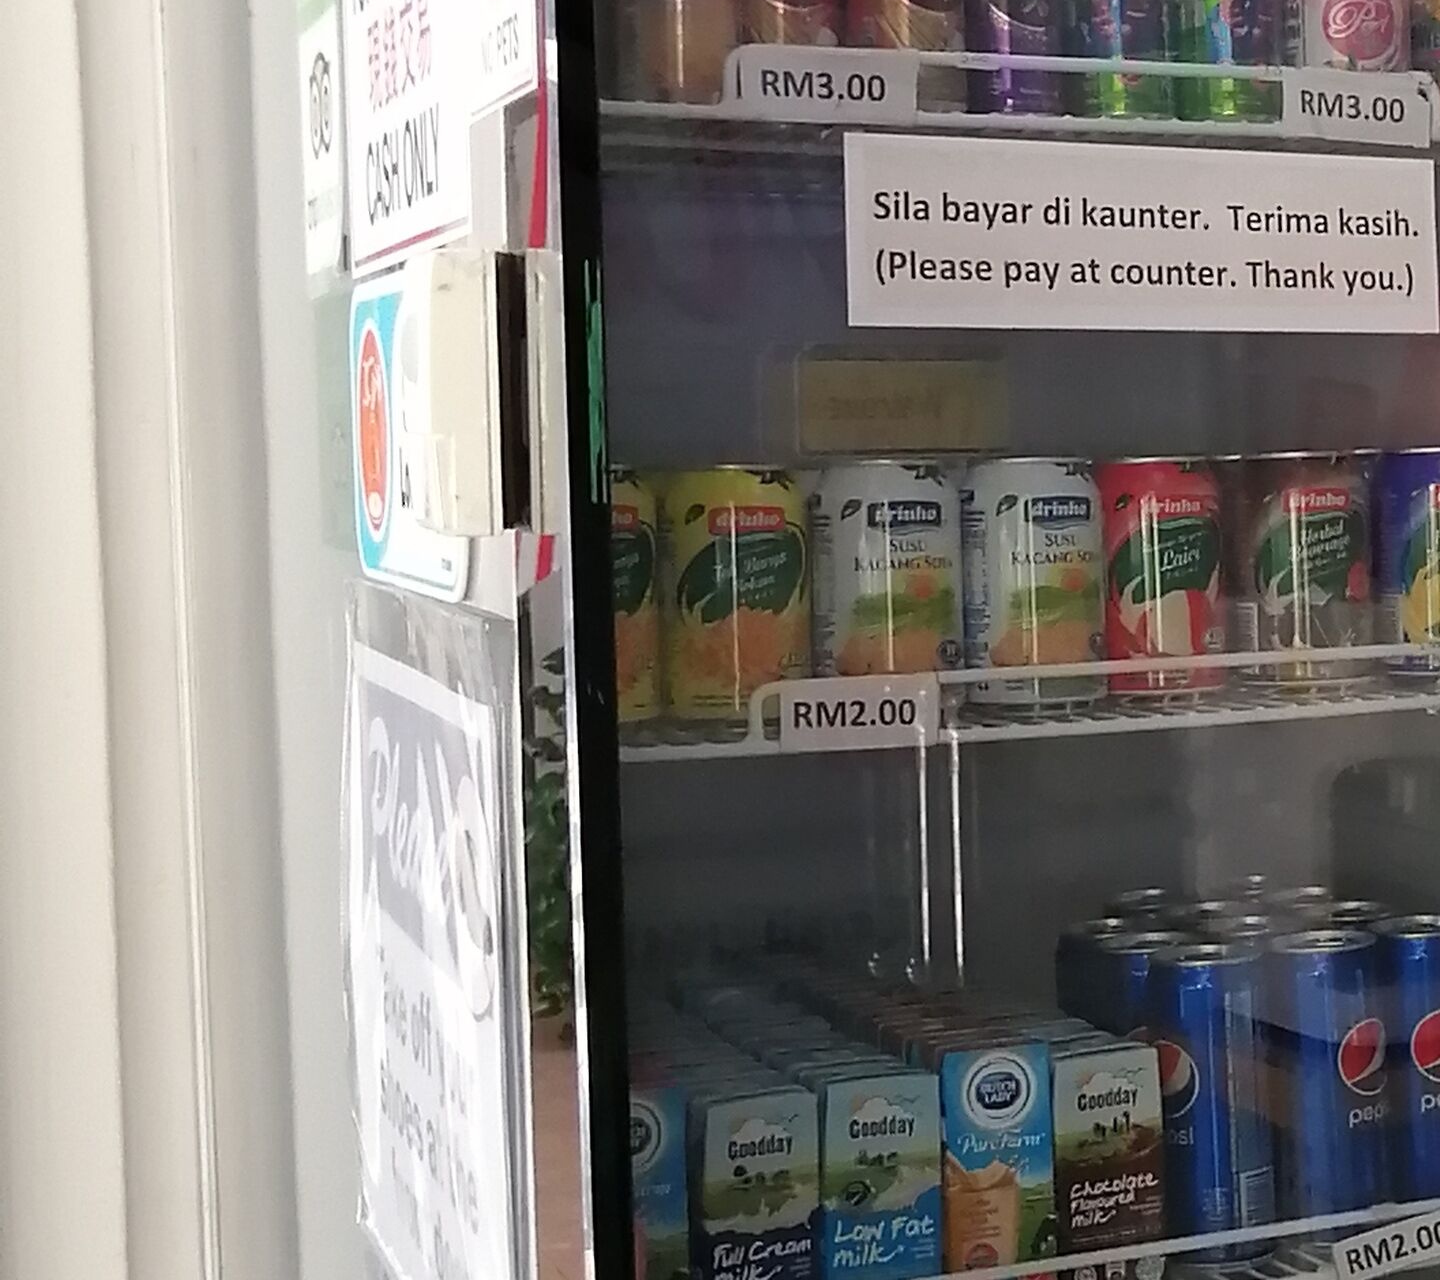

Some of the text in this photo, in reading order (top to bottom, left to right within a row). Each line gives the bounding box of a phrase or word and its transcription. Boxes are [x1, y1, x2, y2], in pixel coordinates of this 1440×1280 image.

[497, 12, 519, 66] PETS
[760, 69, 886, 102] RM3.00
[1300, 89, 1405, 124] RM3.00
[366, 101, 439, 226] CASH ONLY
[873, 191, 1420, 239] Sila bayar di kaunter. Terima kasih.
[875, 249, 1415, 296] (Please pay at counter. Thank you.)
[1030, 499, 1089, 518] drinho
[793, 698, 917, 730] RM2.00
[1076, 1087, 1139, 1112] Goodday
[849, 1114, 915, 1139] Goodday
[834, 1214, 935, 1244] Low Fat
[1071, 1208, 1117, 1231] milk
[712, 1238, 812, 1270] Full Cream
[832, 1244, 902, 1269] milk
